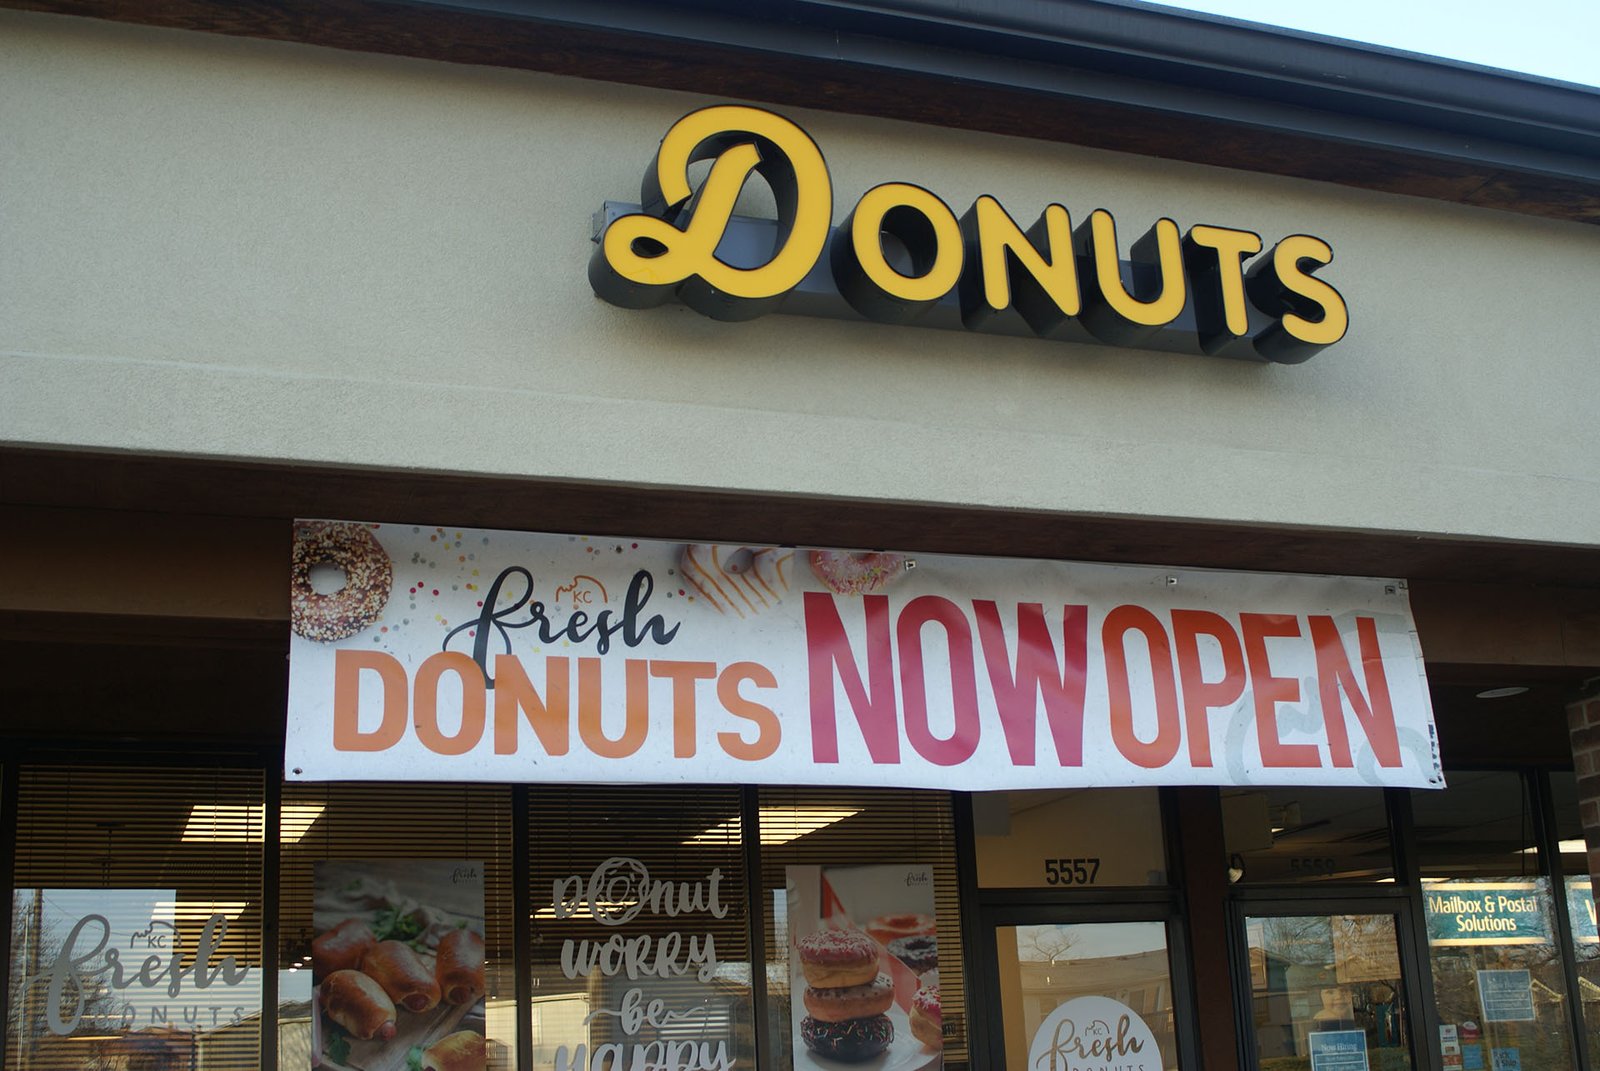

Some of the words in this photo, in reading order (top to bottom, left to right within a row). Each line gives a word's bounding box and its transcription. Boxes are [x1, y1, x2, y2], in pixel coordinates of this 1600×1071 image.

[602, 104, 1349, 346] DONUTS
[572, 590, 593, 604] KC
[443, 566, 680, 689] fresh
[333, 649, 782, 761] DONUTS
[803, 592, 1088, 767] NOW
[1101, 604, 1403, 769] OPEN
[1045, 858, 1100, 885] 5557
[1428, 896, 1482, 914] Mailbox
[1484, 896, 1496, 913] &
[1498, 896, 1538, 913] Postal
[1456, 915, 1517, 933] Solutions
[147, 935, 167, 949] KC
[20, 914, 252, 1035] fresh
[1036, 1014, 1144, 1071] fresh
